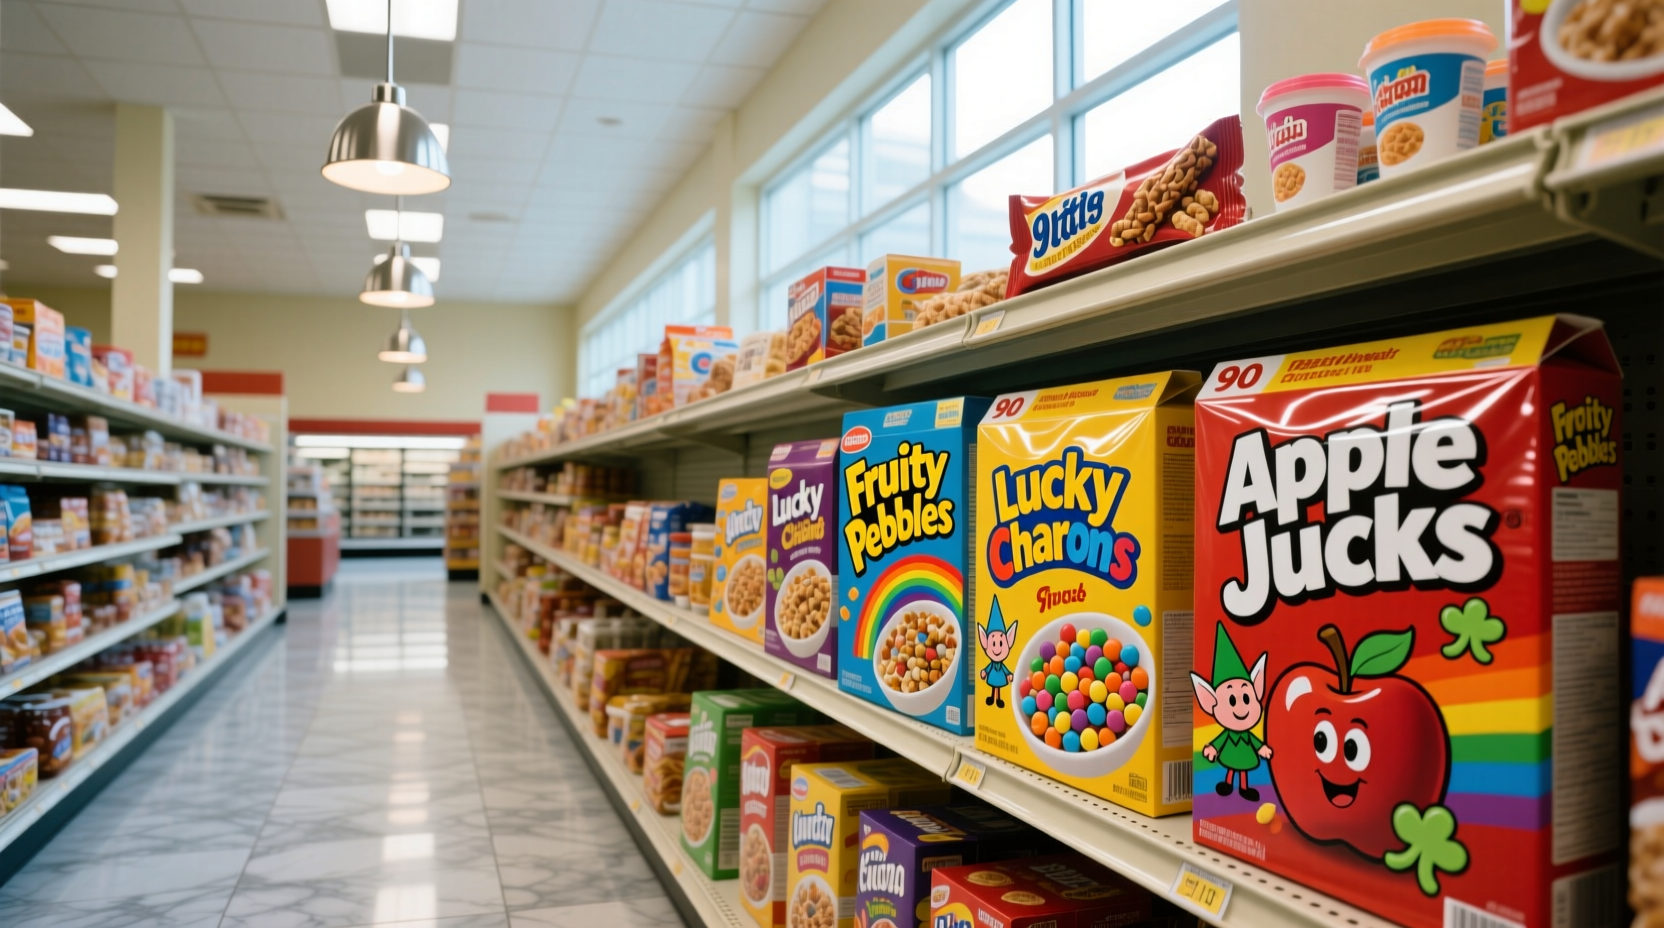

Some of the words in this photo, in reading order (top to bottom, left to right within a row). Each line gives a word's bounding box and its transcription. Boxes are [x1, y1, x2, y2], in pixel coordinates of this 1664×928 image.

[991, 396, 1025, 419] 90
[1214, 362, 1264, 392] 90
[844, 442, 949, 517] Fruity
[993, 450, 1126, 528] Lucky
[1218, 400, 1480, 528] Apple
[1552, 431, 1617, 483] Pebbles
[844, 492, 954, 575] Pebbles
[988, 520, 1136, 582] Charons
[1221, 492, 1495, 618] Jucks
